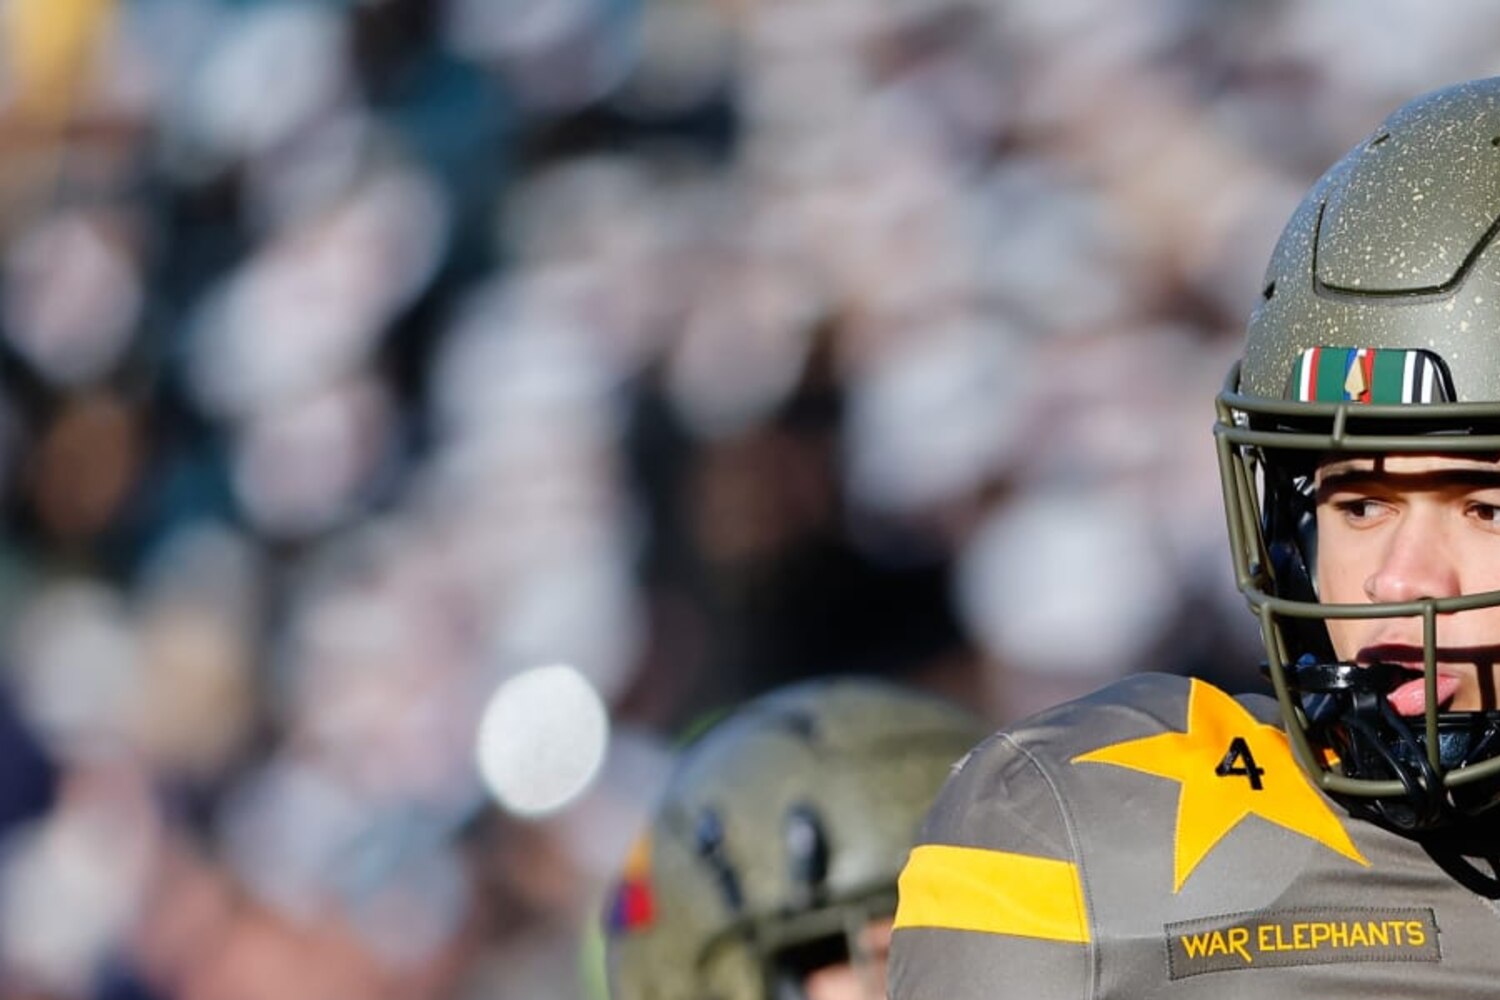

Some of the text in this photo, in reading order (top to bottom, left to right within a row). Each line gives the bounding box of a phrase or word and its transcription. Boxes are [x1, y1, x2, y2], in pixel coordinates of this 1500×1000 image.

[1215, 736, 1264, 790] 4
[1182, 920, 1426, 963] WAR ELEPHANTS
